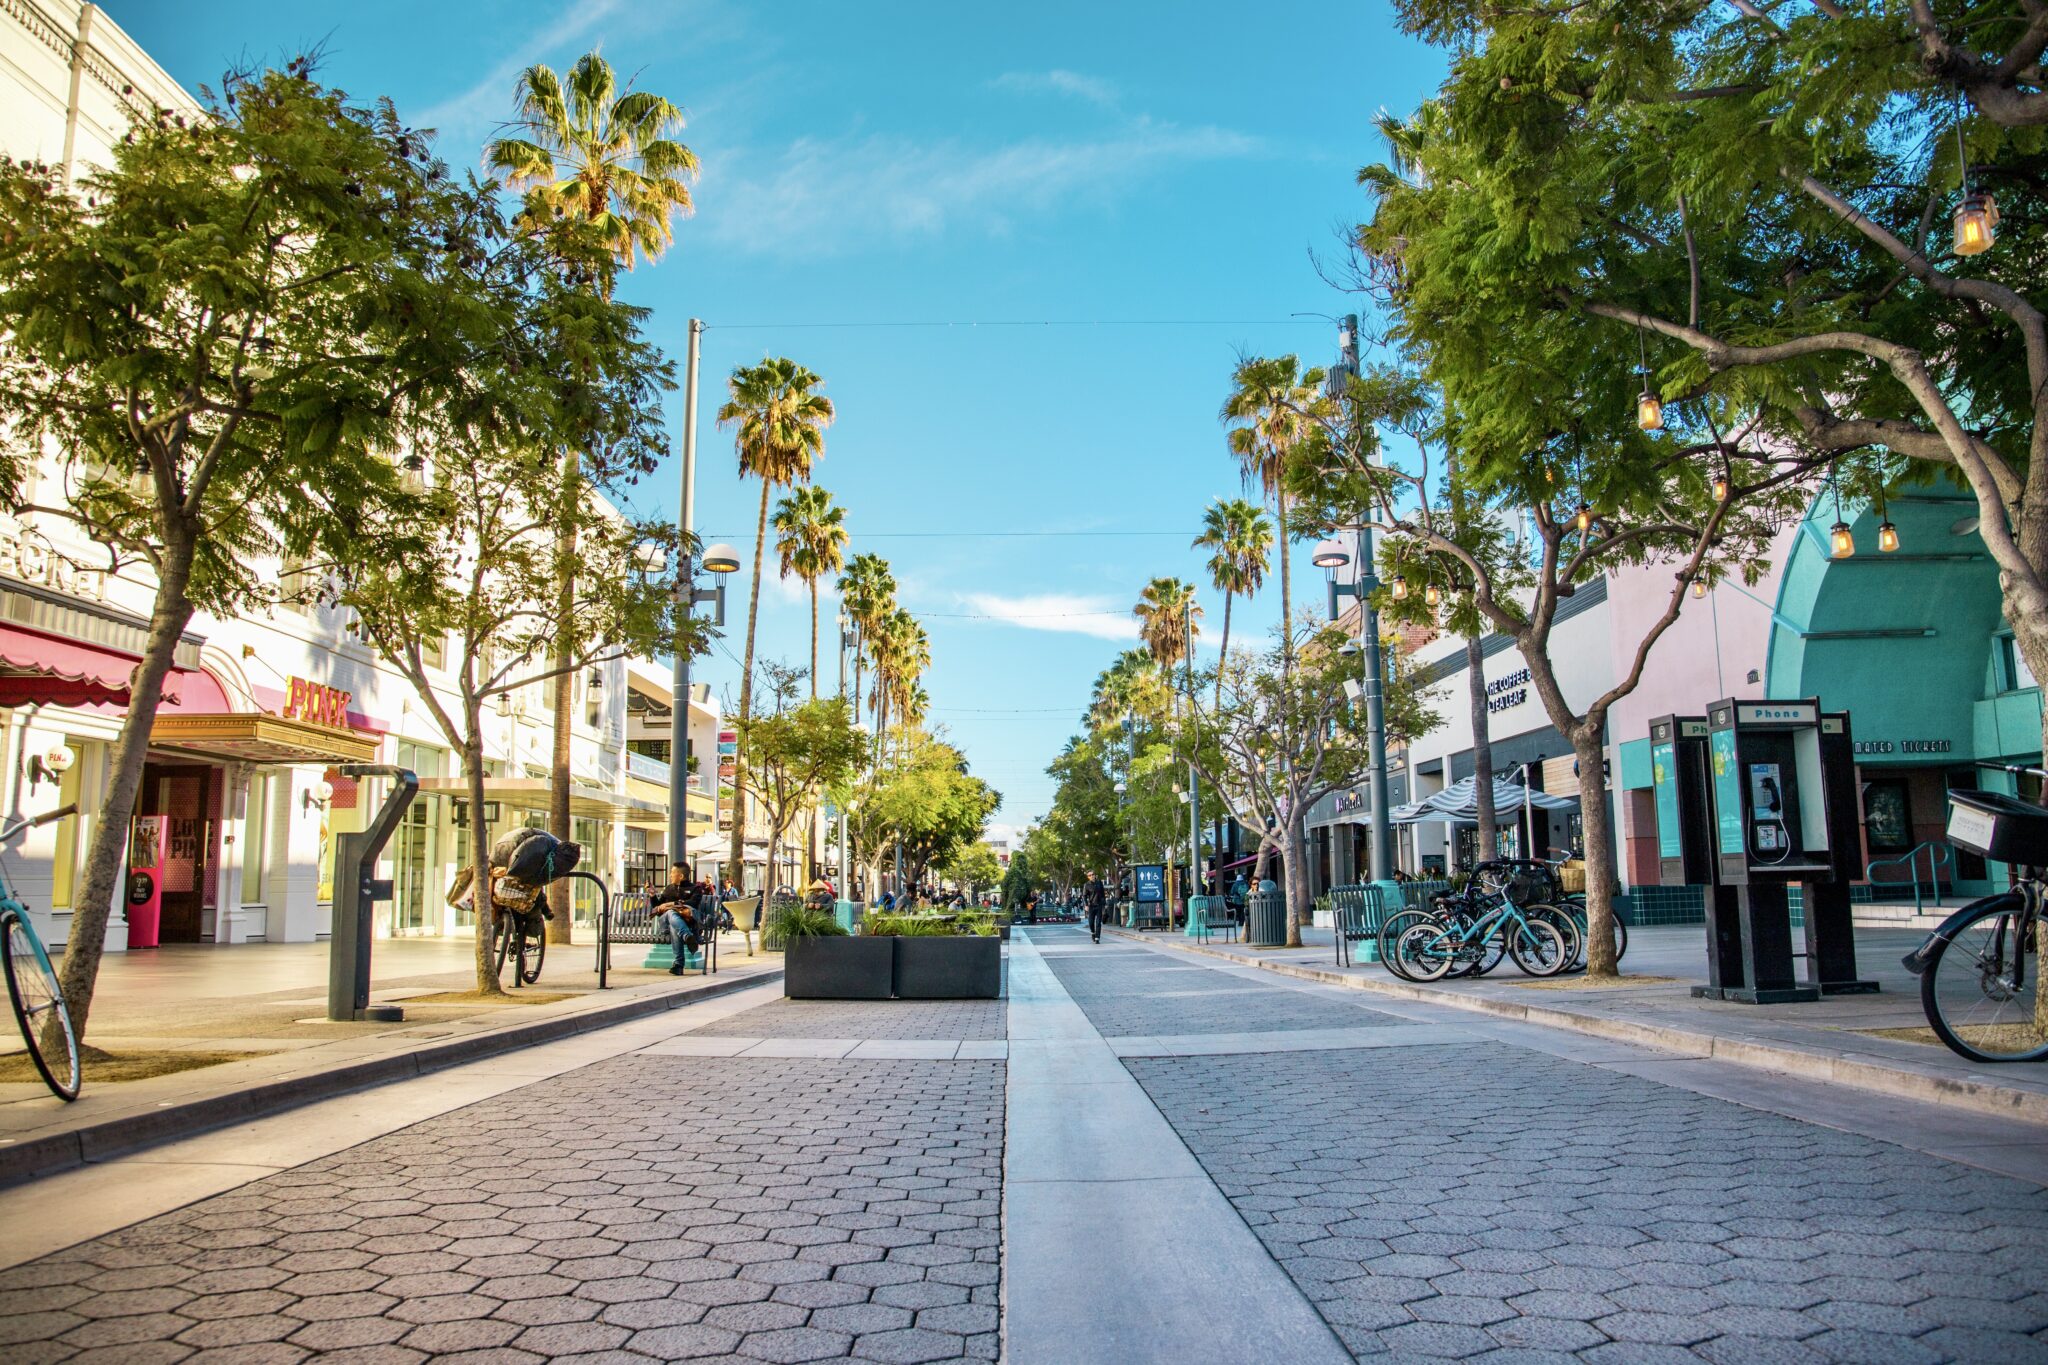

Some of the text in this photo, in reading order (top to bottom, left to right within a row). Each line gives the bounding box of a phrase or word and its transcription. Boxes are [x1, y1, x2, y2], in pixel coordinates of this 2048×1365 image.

[1488, 680, 1500, 695] HE
[1500, 669, 1526, 691] COFFEE
[286, 675, 352, 729] PINK
[1492, 697, 1506, 712] TEA
[1506, 689, 1526, 708] LEAF
[1755, 709, 1800, 718] Phone
[1902, 741, 1951, 753] TICKETS
